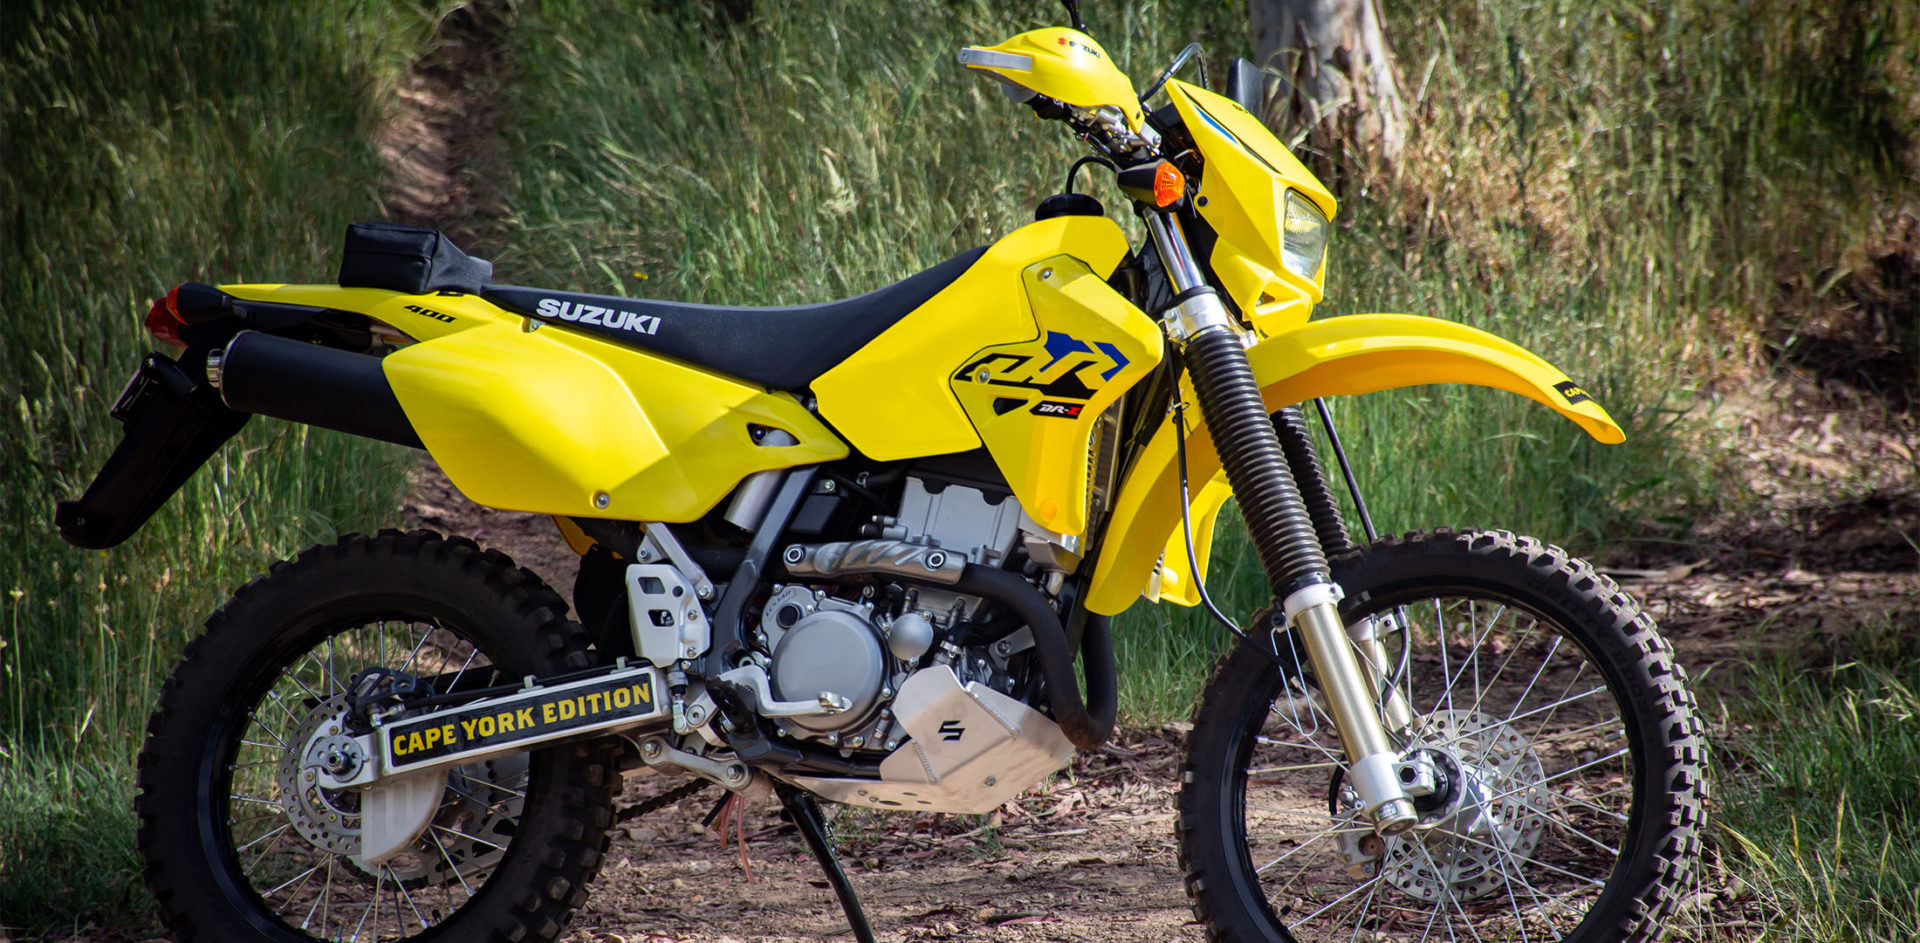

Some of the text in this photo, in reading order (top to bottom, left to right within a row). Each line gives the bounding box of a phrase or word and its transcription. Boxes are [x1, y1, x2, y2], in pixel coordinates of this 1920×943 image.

[1068, 40, 1101, 59] SZUKI
[403, 305, 457, 323] 400
[536, 298, 662, 336] SUZUKI
[1038, 403, 1081, 416] DR-Z
[393, 682, 650, 756] CAPE YORK EDITION
